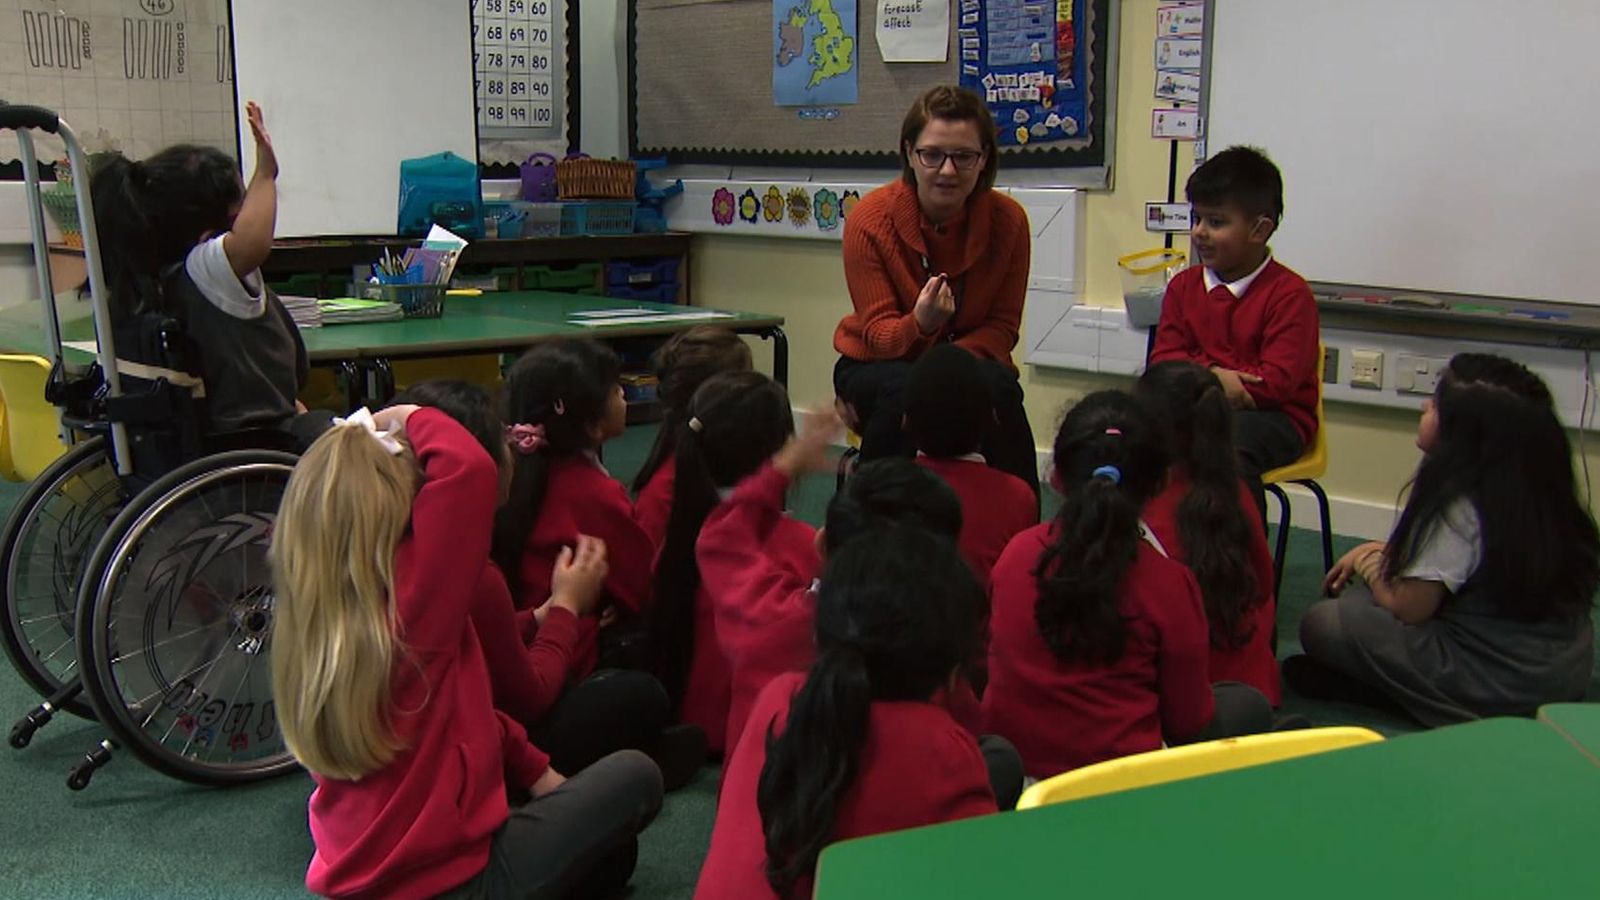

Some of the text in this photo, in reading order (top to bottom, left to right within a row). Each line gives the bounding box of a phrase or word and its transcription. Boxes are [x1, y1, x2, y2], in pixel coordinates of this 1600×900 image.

[486, 0, 502, 12] 58
[509, 0, 524, 13] 59
[531, 2, 547, 15] 60
[884, 4, 922, 14] forecast
[884, 16, 912, 29] affect
[487, 27, 502, 39] 68
[510, 28, 524, 41] 69
[532, 29, 547, 42] 70
[1178, 49, 1200, 57] English
[488, 53, 503, 67] 78
[510, 55, 525, 68] 79
[532, 56, 547, 69] 80
[488, 80, 503, 94] 88
[510, 82, 525, 94] 89
[533, 82, 549, 95] 90
[488, 107, 503, 120] 98
[510, 108, 525, 120] 99
[533, 109, 550, 121] 100
